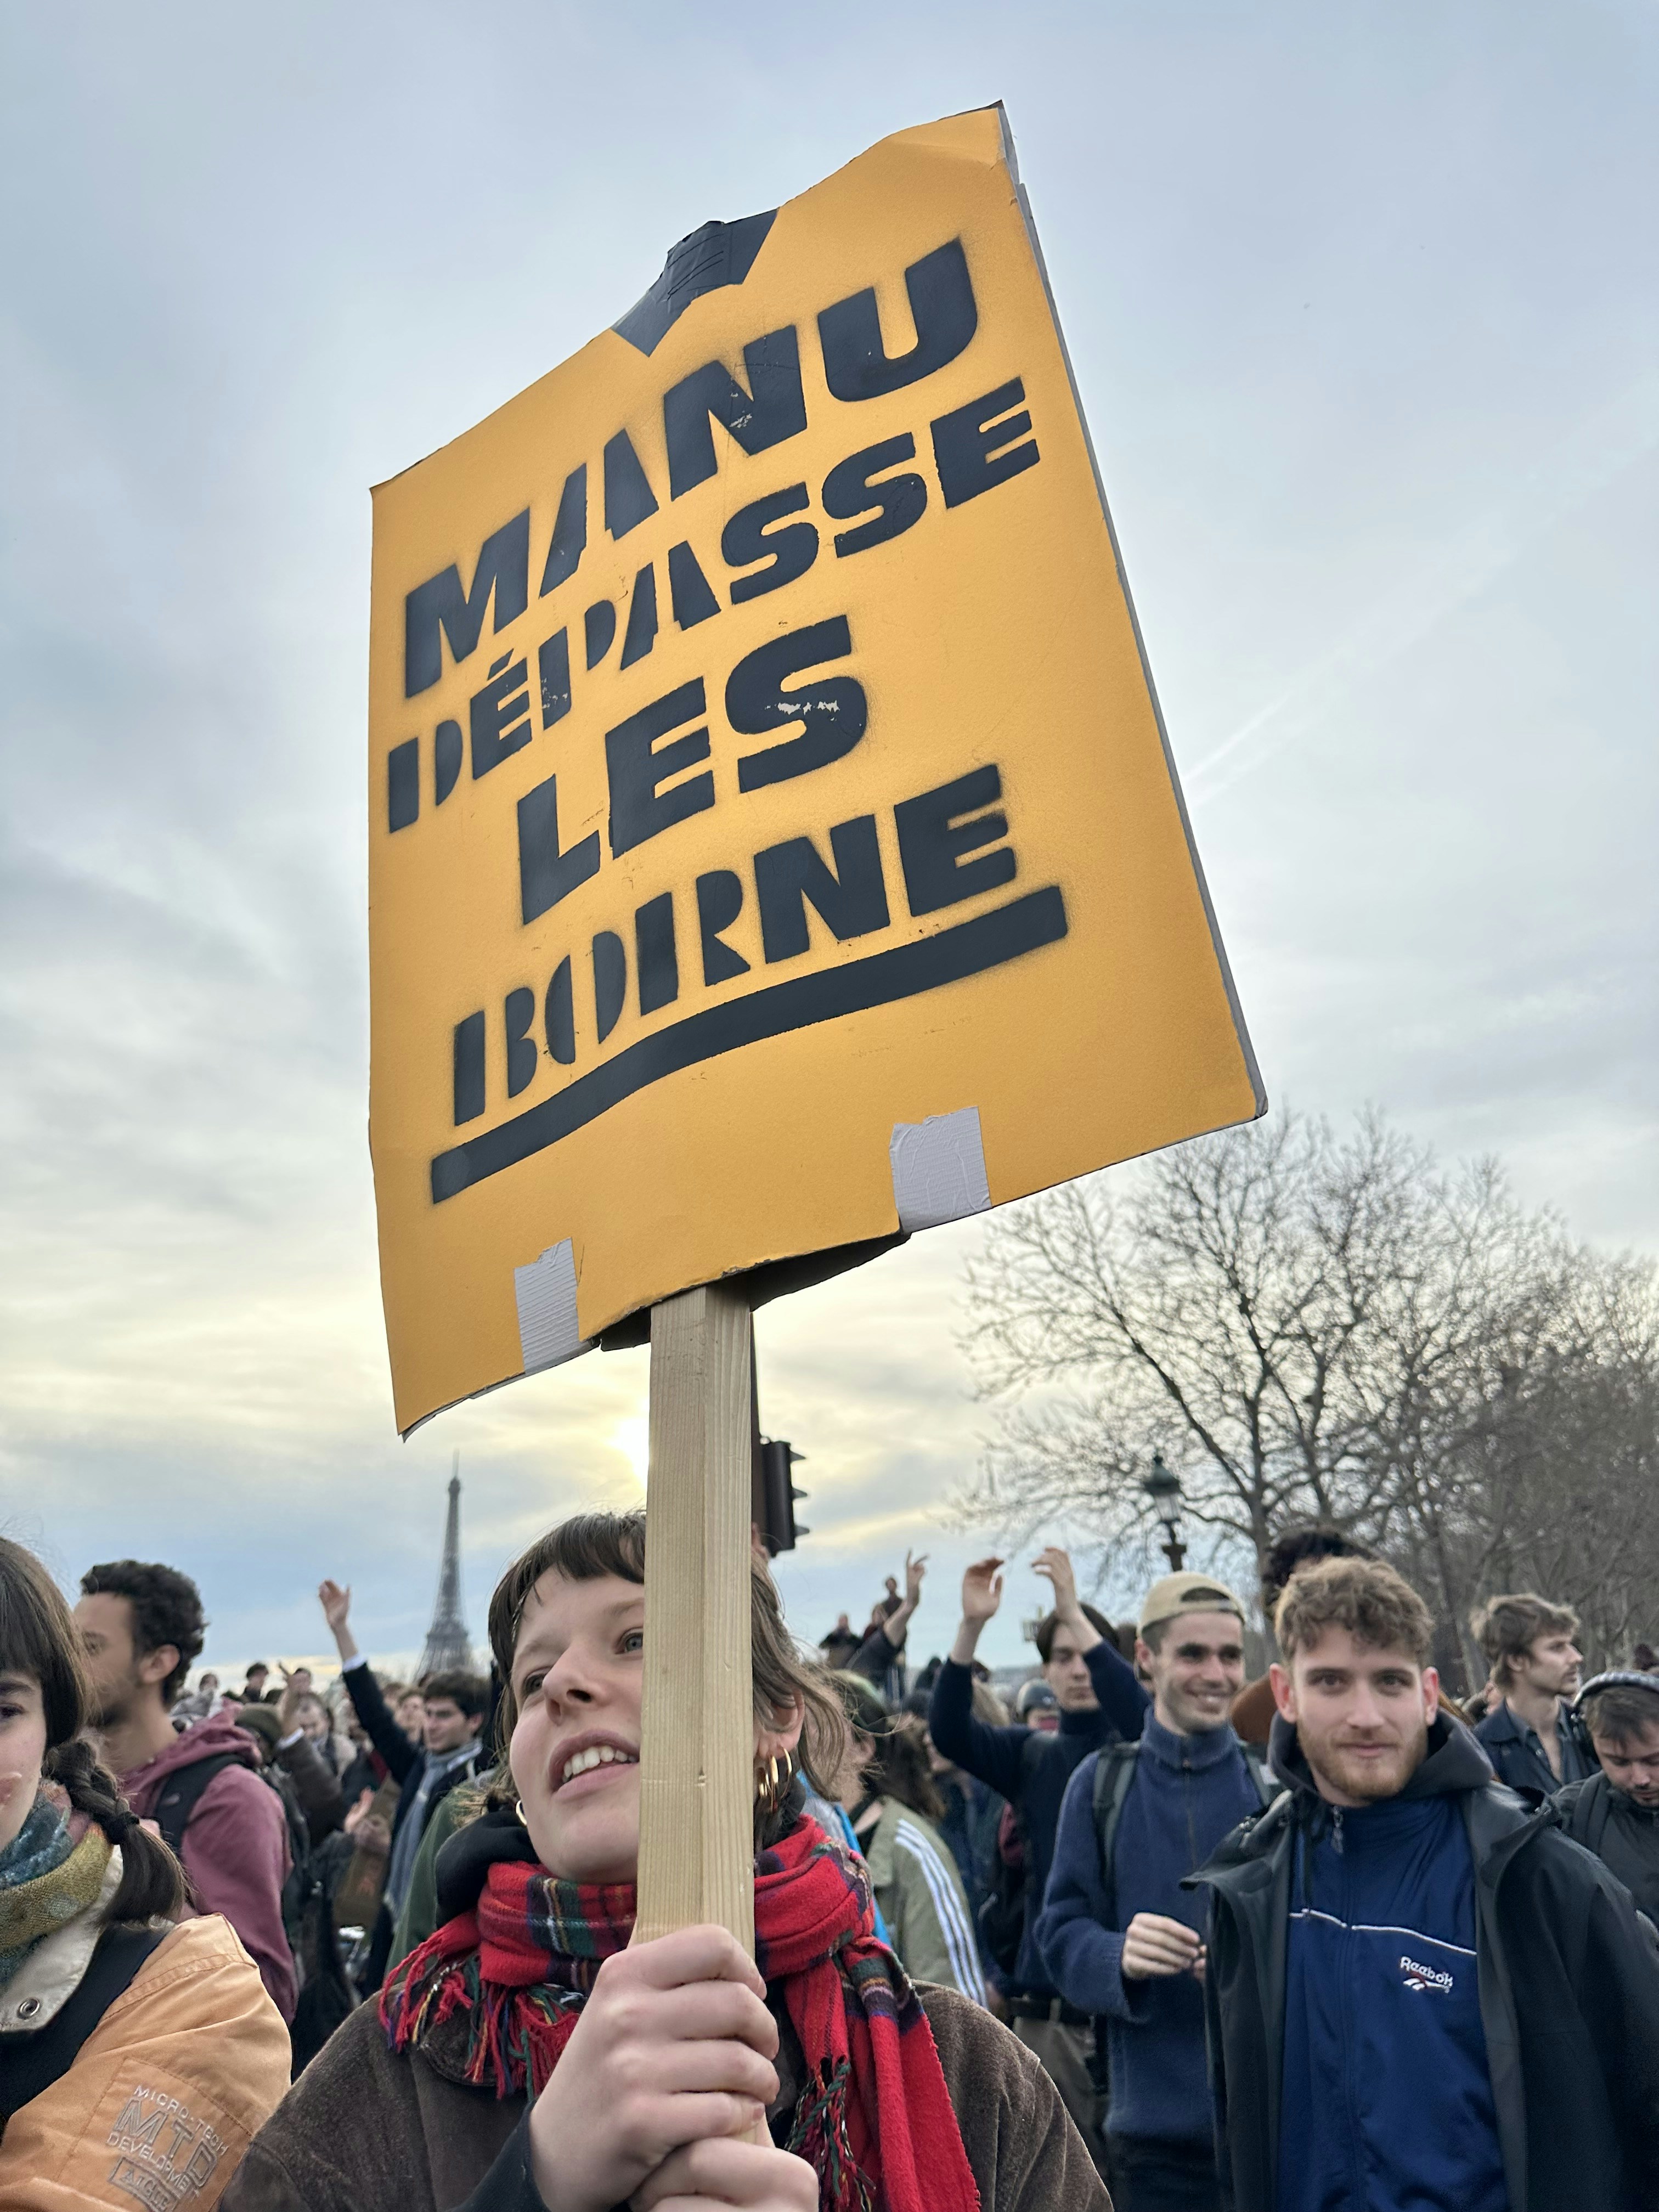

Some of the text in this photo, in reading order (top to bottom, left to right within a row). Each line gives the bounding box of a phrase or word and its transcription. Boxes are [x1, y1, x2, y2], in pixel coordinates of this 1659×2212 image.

[387, 377, 1040, 833] DÉPASSE
[405, 236, 978, 699] MANU
[517, 614, 868, 926] LES
[453, 764, 1018, 1127] BORNE
[1400, 1955, 1454, 1987] Reebok
[113, 2098, 217, 2188] MTD
